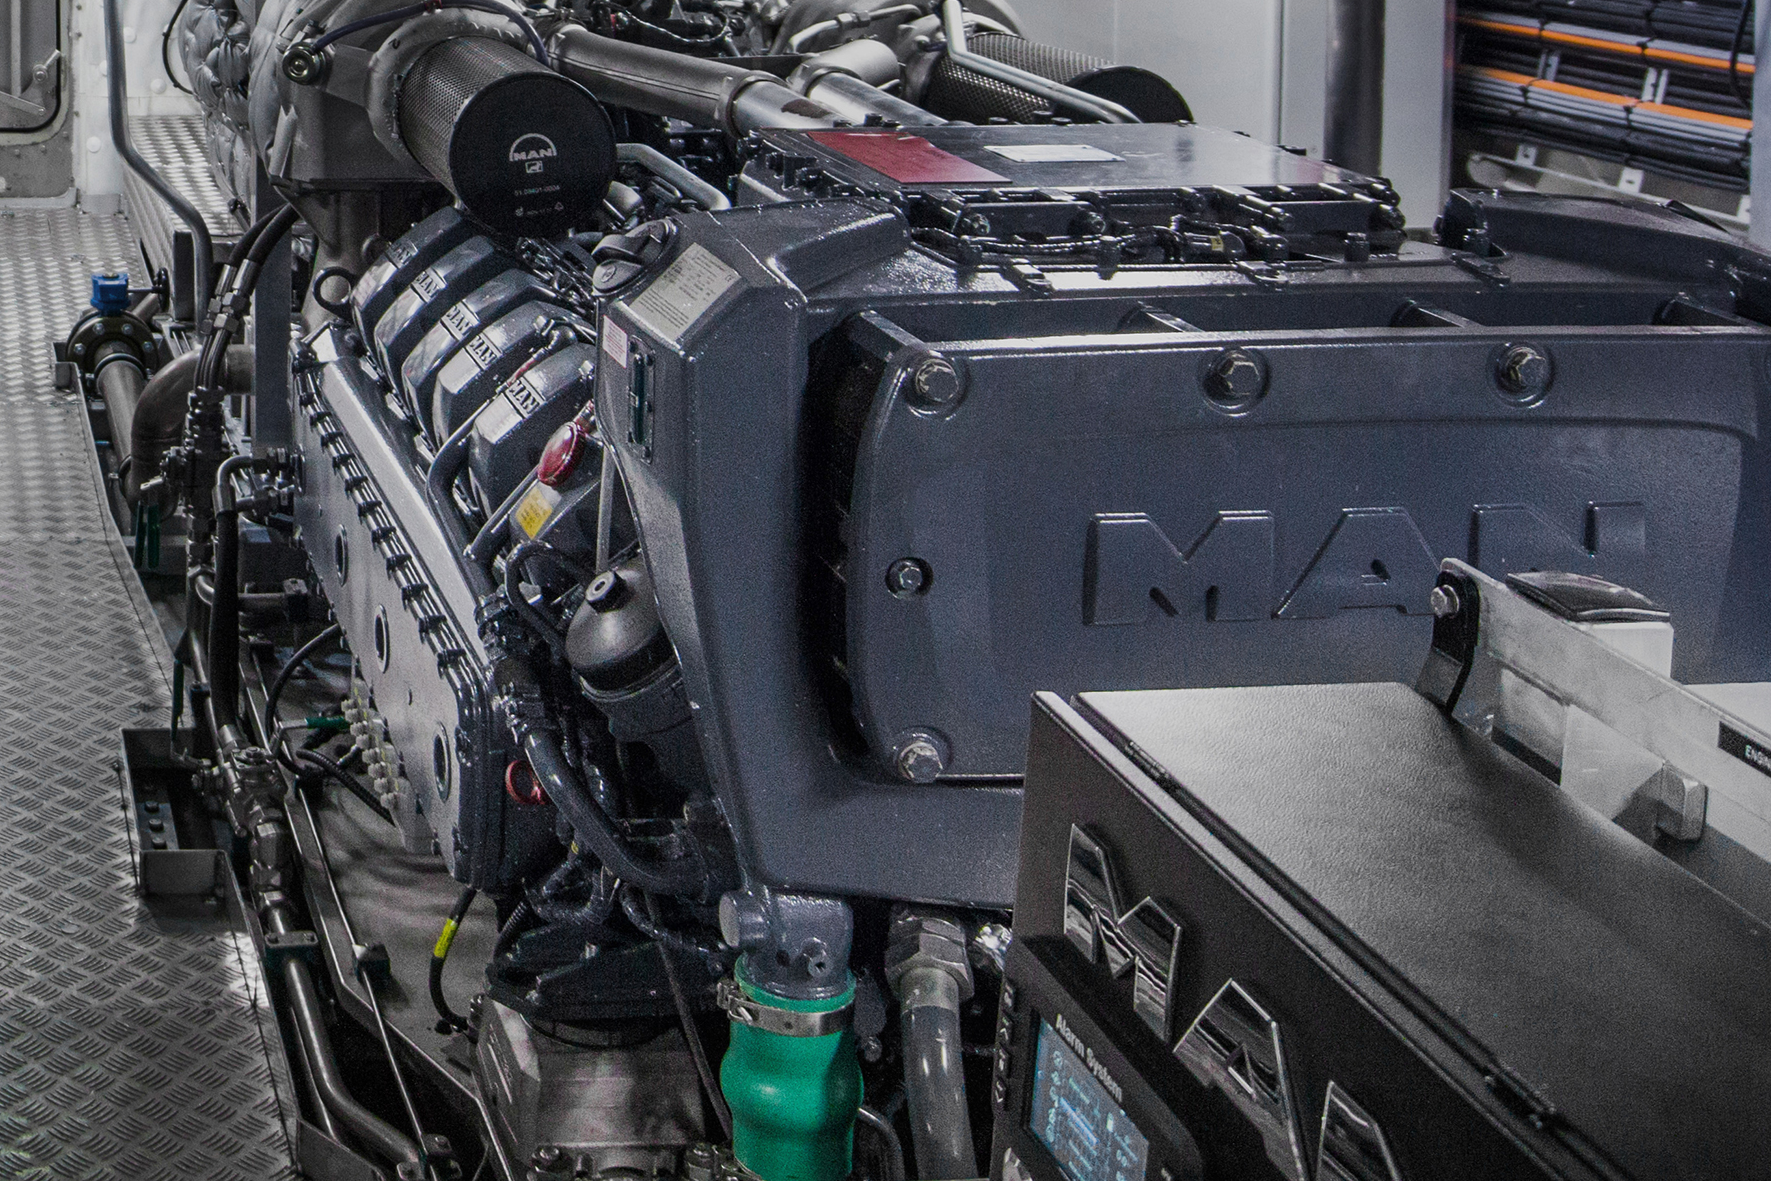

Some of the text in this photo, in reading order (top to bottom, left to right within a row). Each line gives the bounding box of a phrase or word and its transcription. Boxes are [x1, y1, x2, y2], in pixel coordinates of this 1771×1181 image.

[513, 148, 553, 161] MAN
[415, 270, 440, 298] MAN
[446, 305, 473, 335] MAN
[468, 335, 498, 366] MAN
[509, 379, 541, 414] MAN
[1056, 1013, 1122, 1103] Alarm System
